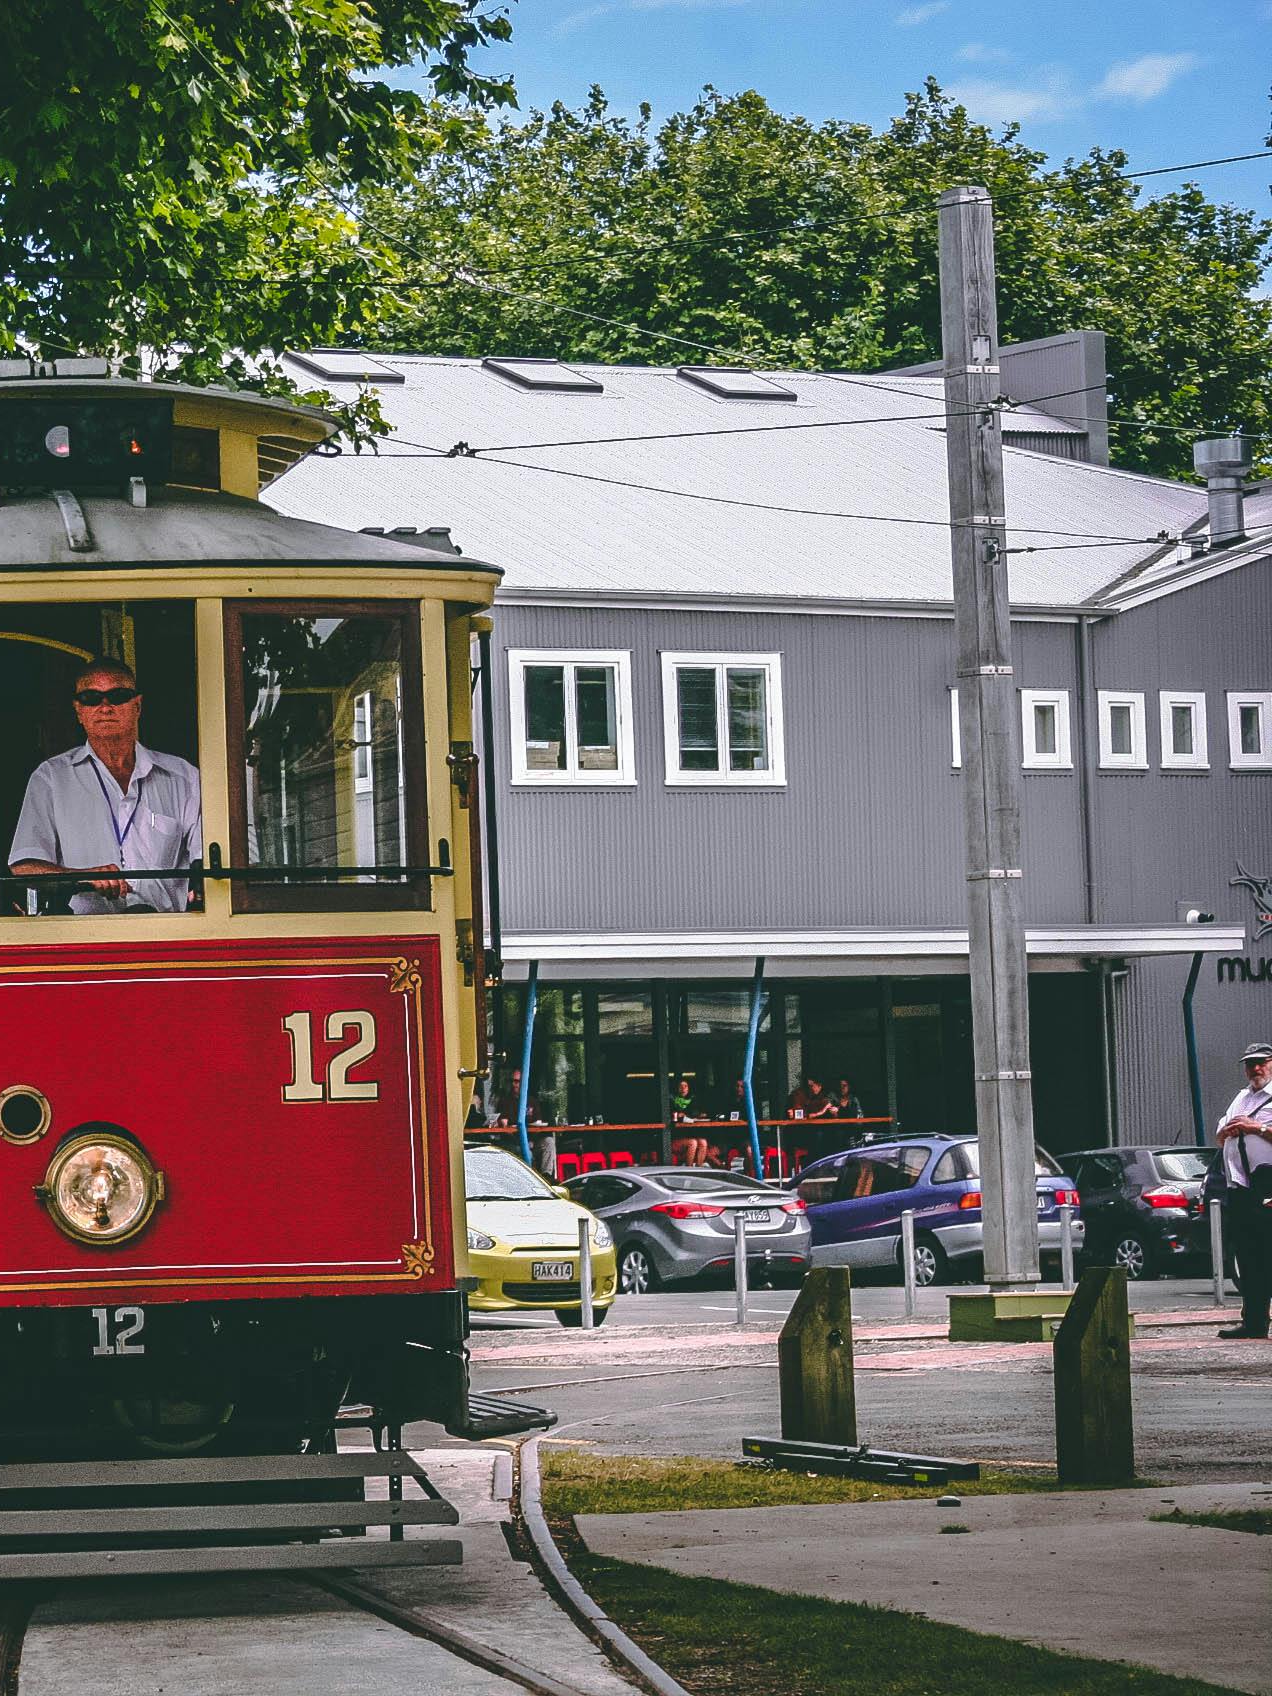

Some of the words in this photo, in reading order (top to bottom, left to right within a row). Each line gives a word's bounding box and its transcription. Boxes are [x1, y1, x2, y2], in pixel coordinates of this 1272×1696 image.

[1216, 957, 1272, 983] mu
[281, 1009, 379, 1104] 12
[534, 1264, 571, 1277] HAK414
[92, 1306, 145, 1355] 12
